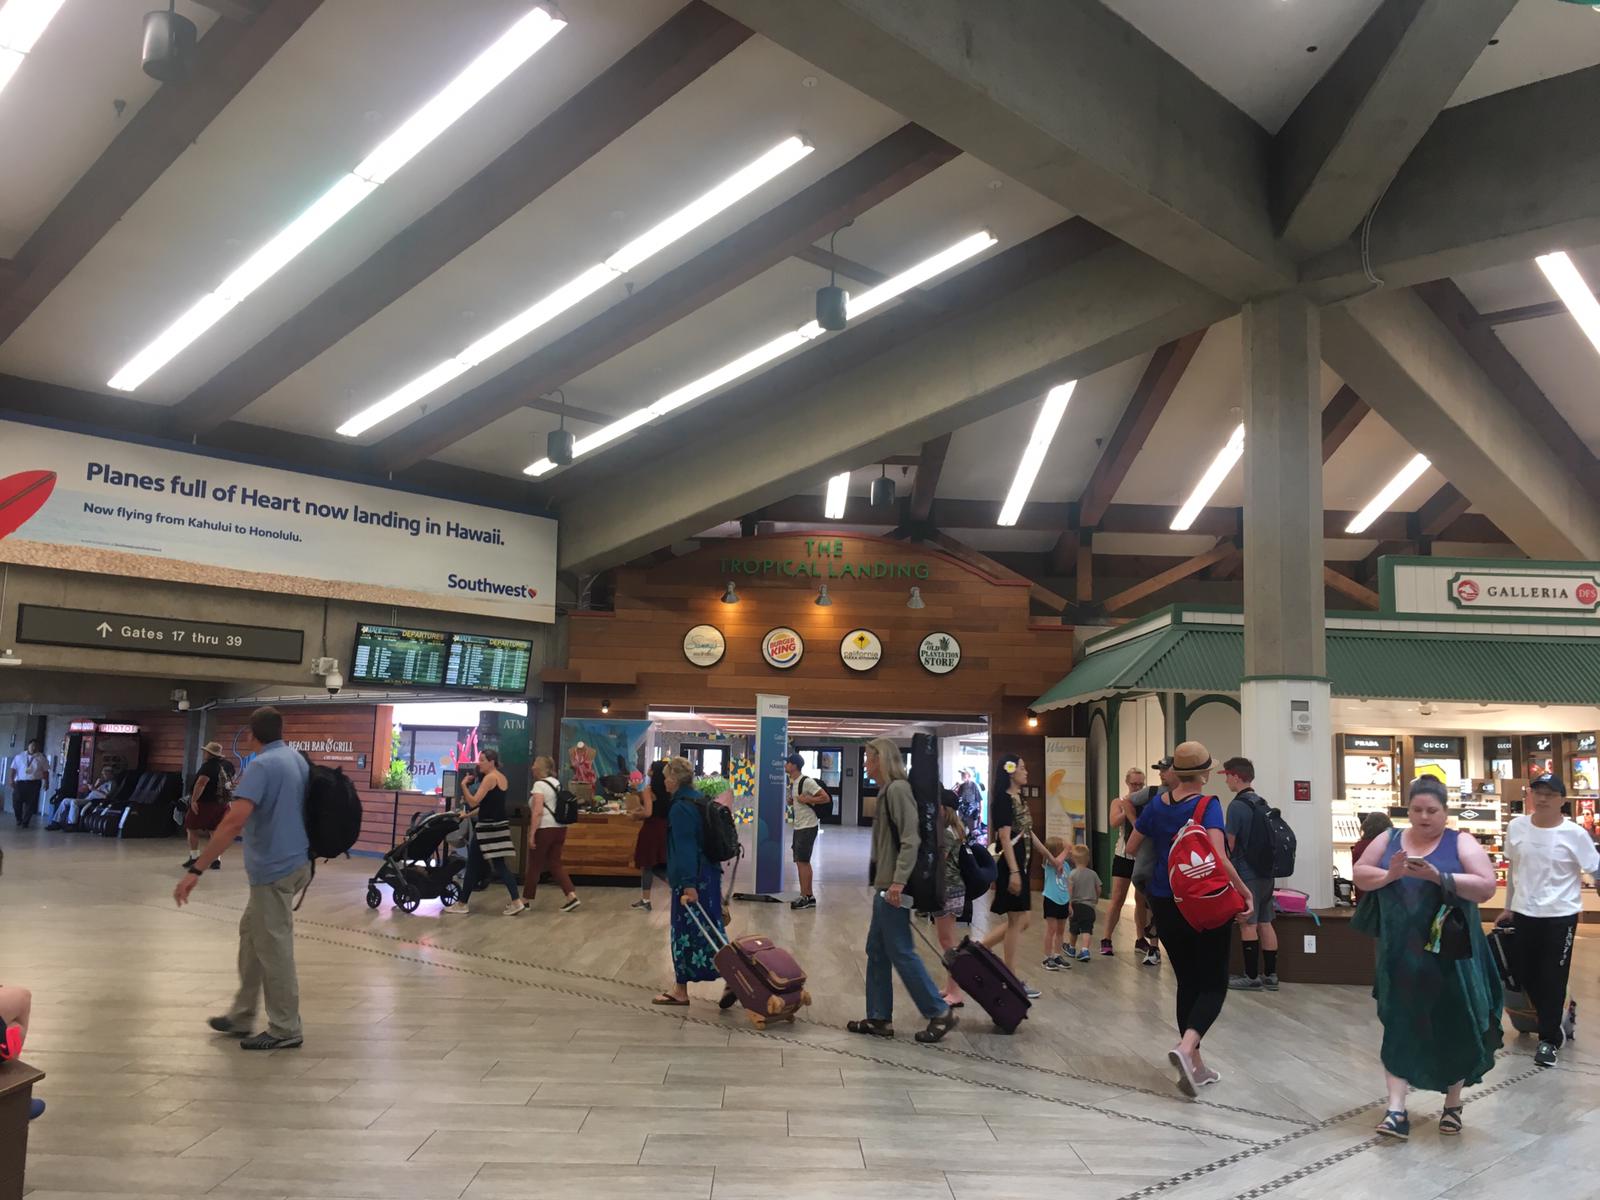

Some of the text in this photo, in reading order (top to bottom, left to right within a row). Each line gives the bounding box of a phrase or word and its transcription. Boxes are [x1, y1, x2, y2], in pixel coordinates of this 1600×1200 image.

[87, 462, 505, 546] Planes full of Heart now landing in Hawaii.
[83, 502, 303, 542] Now flying from Kahului to Honolulu.
[805, 538, 843, 558] THE
[720, 557, 929, 580] TROPICAL LANDING
[448, 574, 527, 598] Southwest
[1487, 586, 1569, 599] GALLERIA
[1578, 589, 1597, 598] DFS
[121, 626, 242, 647] Gates 17 thru 39
[769, 637, 795, 649] BURGER
[771, 643, 796, 657] KING
[924, 658, 955, 667] STORE
[503, 719, 525, 729] ATM
[288, 738, 354, 753] BEACH BAR & GRILL
